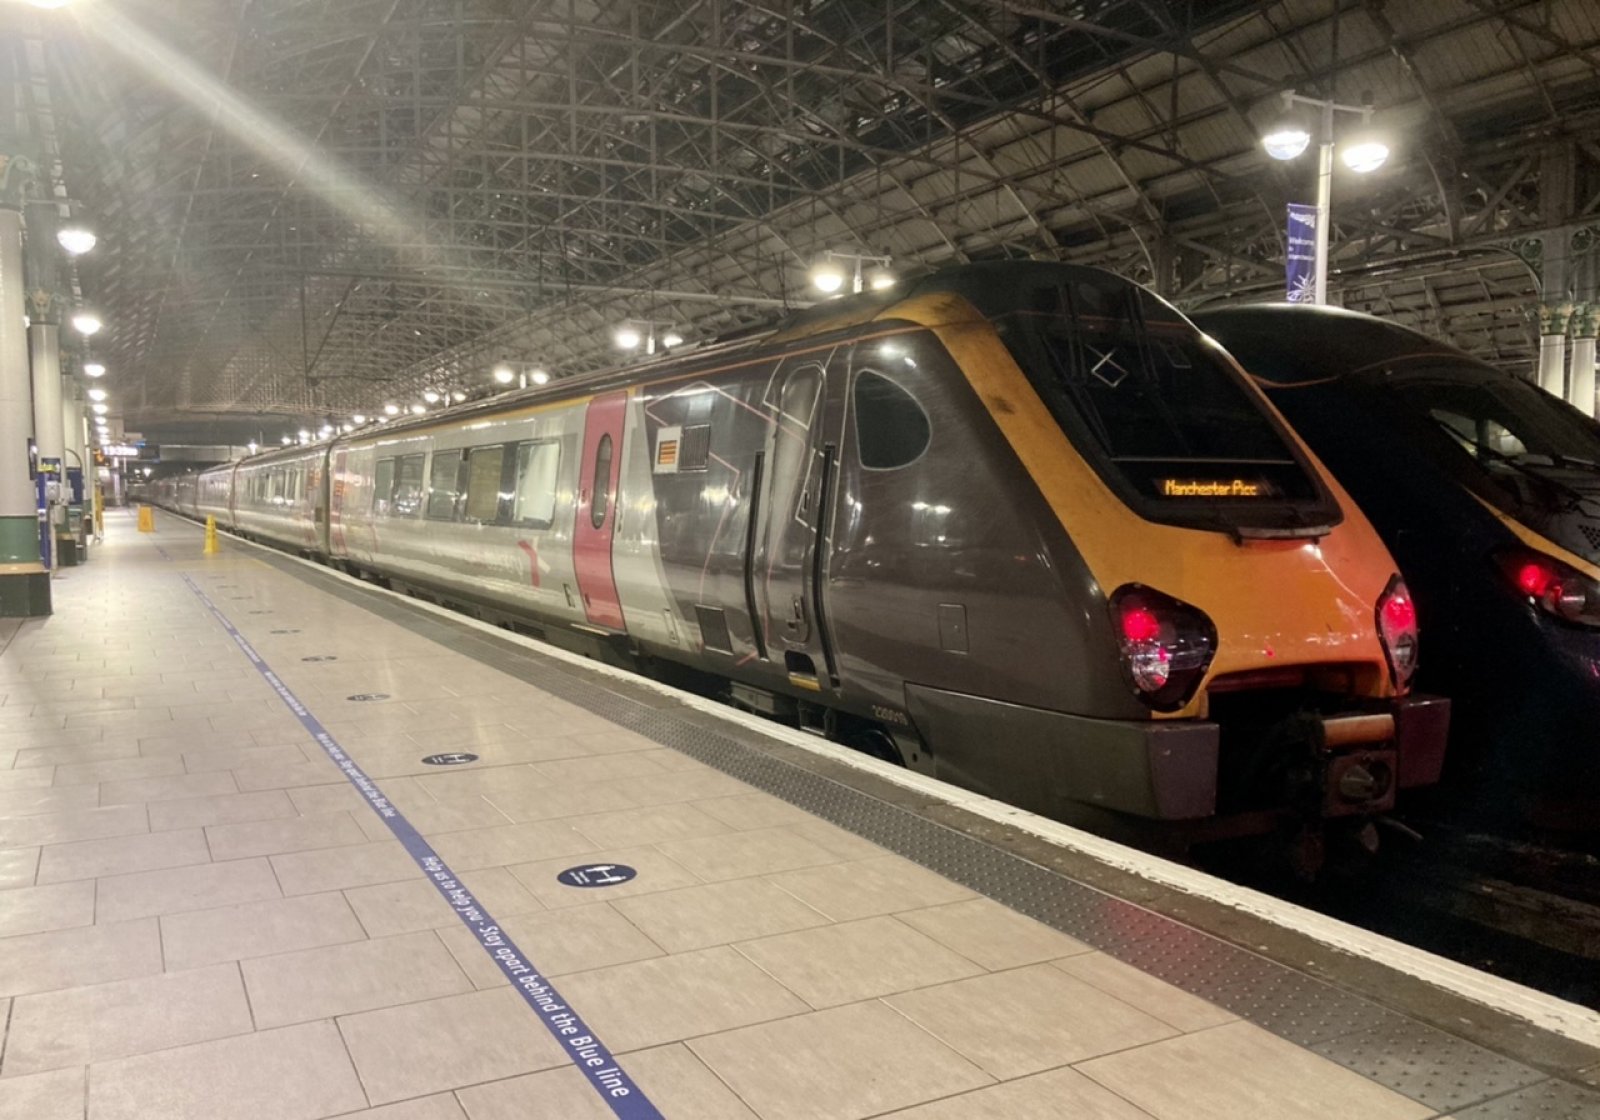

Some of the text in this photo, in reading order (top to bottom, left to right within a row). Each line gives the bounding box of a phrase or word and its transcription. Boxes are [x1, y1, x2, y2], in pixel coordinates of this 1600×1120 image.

[1165, 479, 1231, 495] Manchester
[422, 856, 630, 1097] Help us to help you Stay apart behind the Blue line
